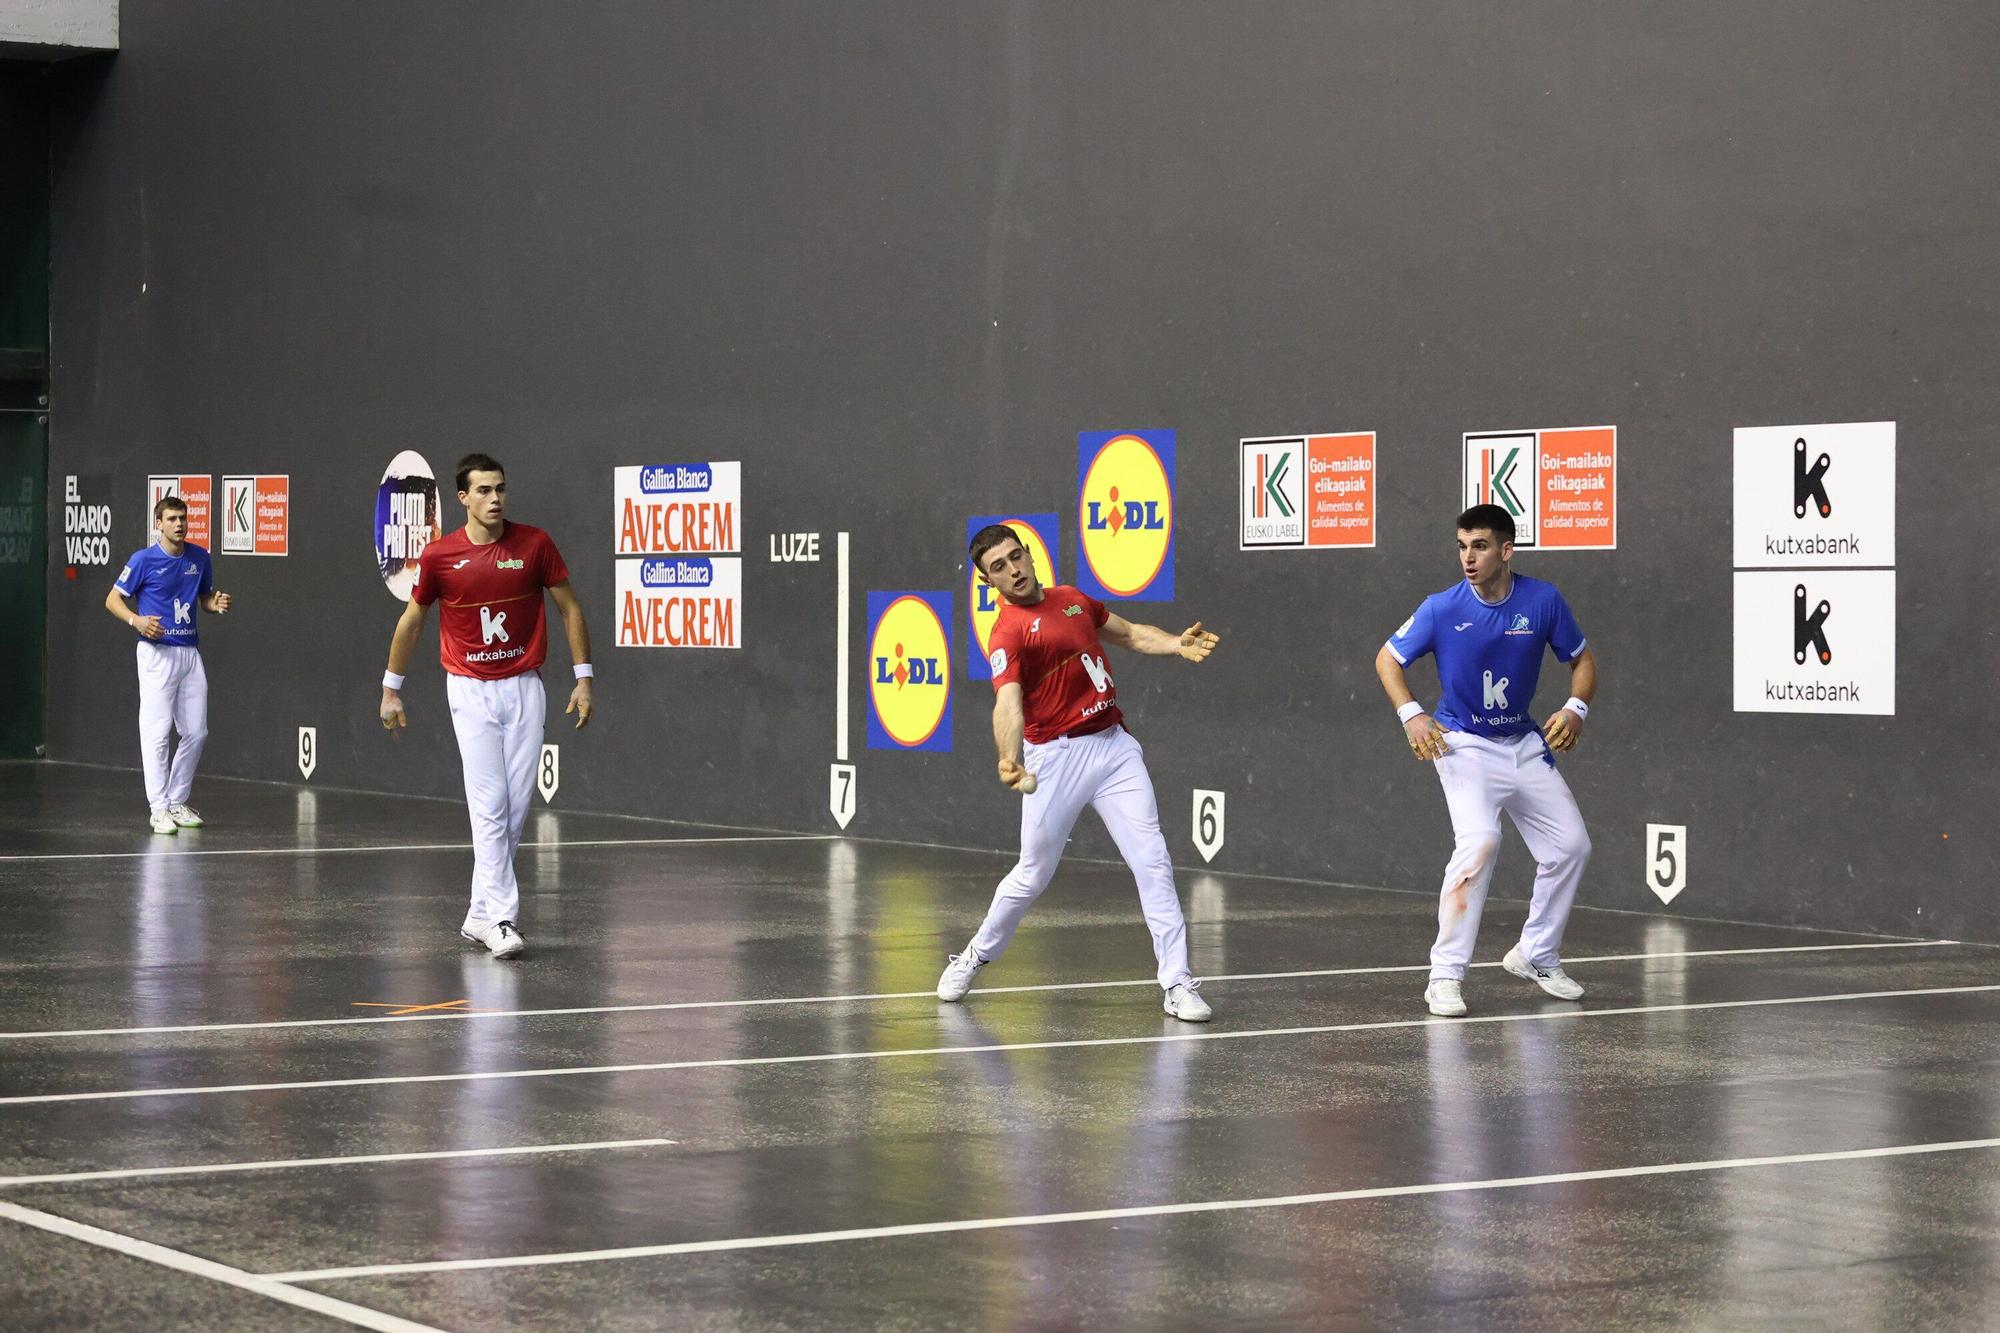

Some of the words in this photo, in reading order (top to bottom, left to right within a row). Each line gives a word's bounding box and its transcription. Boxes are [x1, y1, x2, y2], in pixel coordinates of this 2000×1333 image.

[1309, 456, 1372, 473] Goi-mailako
[1541, 452, 1612, 470] Goi-mailako
[66, 475, 80, 503] EL
[643, 469, 675, 490] Gallina
[676, 467, 708, 488] Blanca
[1314, 476, 1366, 496] elikagaiak
[1547, 474, 1605, 494] elikagaiak
[390, 493, 425, 526] PILOTO
[1316, 501, 1353, 513] Alimentos
[1355, 500, 1364, 511] de
[1549, 500, 1591, 512] Alimentos
[1593, 499, 1603, 511] de
[65, 505, 111, 533] DIARIO
[620, 498, 733, 552] AVECREM
[1246, 524, 1273, 538] EUSKO
[1275, 523, 1299, 537] LABEL
[1312, 516, 1338, 528] calidad
[1340, 514, 1370, 529] superior
[1544, 516, 1572, 529] calidad
[1575, 516, 1609, 530] superior
[65, 536, 110, 565] VASCO
[384, 525, 405, 559] PRO
[407, 525, 431, 559] FEST
[770, 533, 820, 562] LUZE
[1766, 532, 1860, 554] kutxabank
[643, 563, 675, 584] Gallina
[677, 562, 709, 583] Blanca
[620, 591, 734, 646] AVECREM
[466, 645, 525, 662] kutxabank
[1766, 680, 1860, 702] kutxabank
[302, 732, 312, 768] 9
[543, 750, 554, 789] 8
[838, 771, 851, 813] 7
[1200, 796, 1217, 846] 6
[1655, 832, 1677, 888] 5
